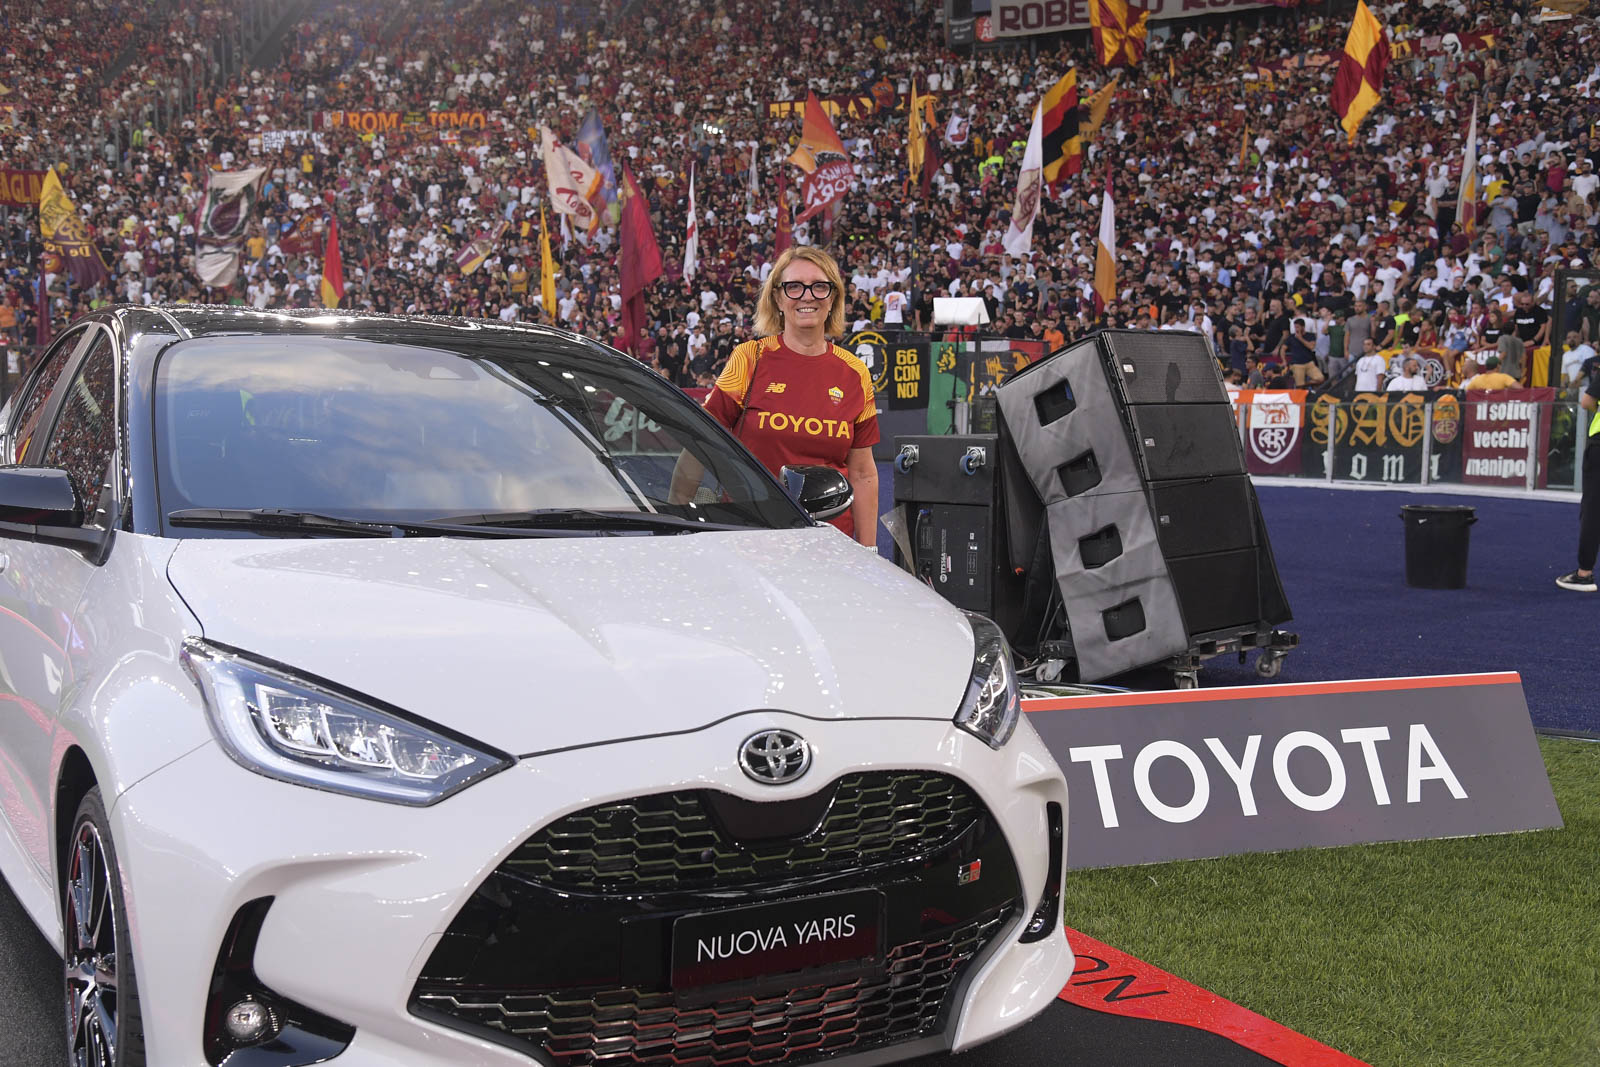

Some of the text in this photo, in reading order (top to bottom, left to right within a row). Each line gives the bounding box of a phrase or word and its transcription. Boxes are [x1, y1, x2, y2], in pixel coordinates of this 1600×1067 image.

[896, 349, 918, 365] 66
[894, 364, 921, 382] CON
[757, 411, 851, 440] TOYOTA
[1465, 455, 1541, 479] manipo
[1068, 723, 1469, 829] TOYOTA
[697, 914, 856, 963] NUOVA YARIS
